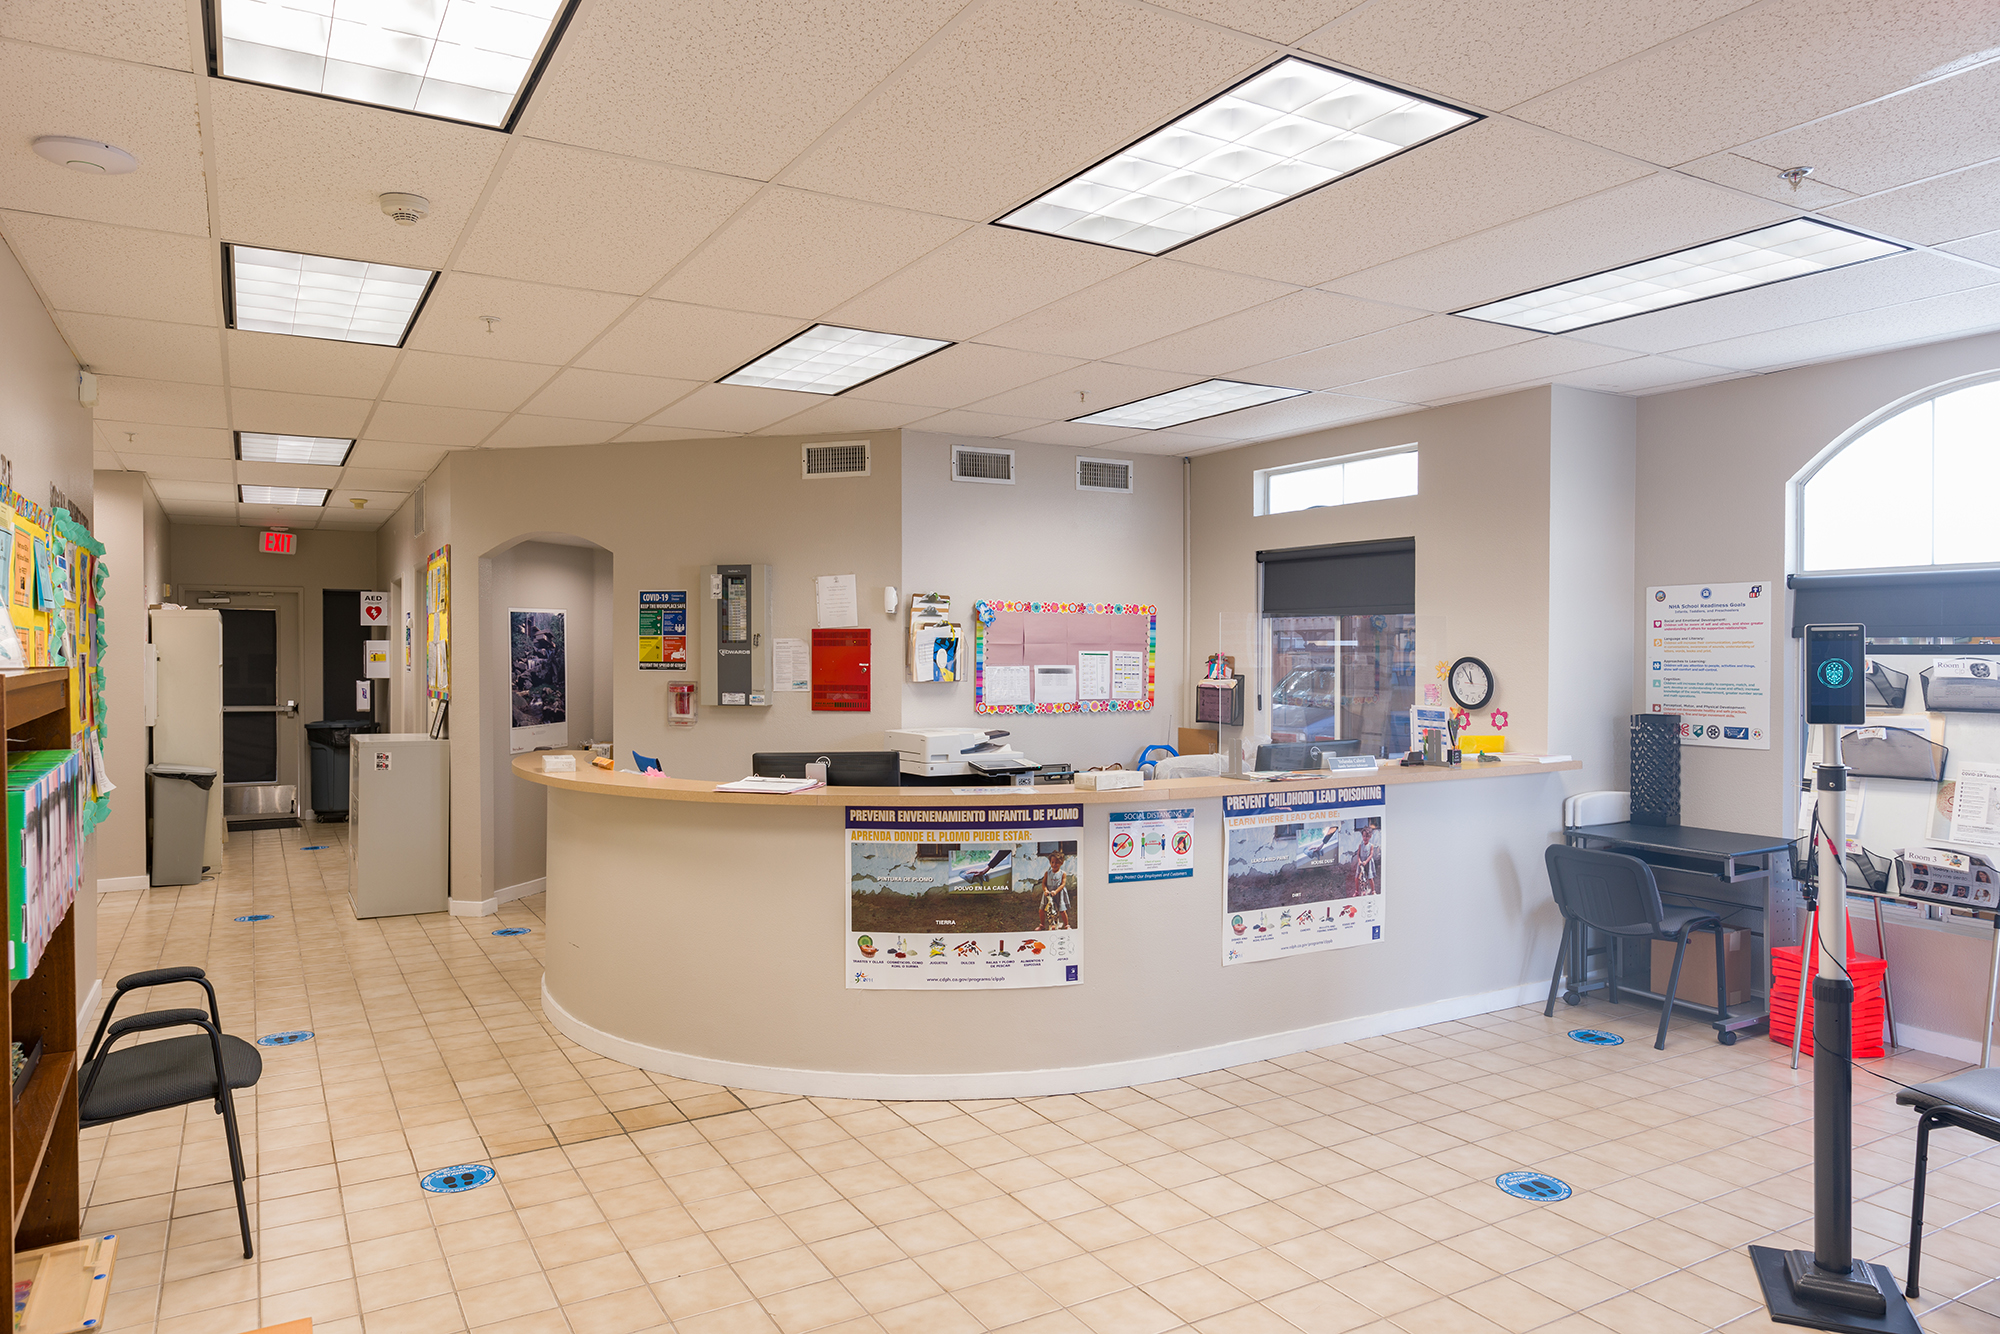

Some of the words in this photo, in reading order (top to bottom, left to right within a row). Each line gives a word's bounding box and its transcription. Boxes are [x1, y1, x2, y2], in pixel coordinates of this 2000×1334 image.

[265, 532, 292, 552] EXIT
[1227, 794, 1266, 810] PREVENT
[1268, 791, 1314, 807] CHILDHOOD
[1316, 789, 1336, 803] LEAD
[1338, 786, 1381, 802] POISONING
[850, 810, 896, 822] PREVENIR
[898, 810, 985, 822] ENVENENAMIENTO
[988, 809, 1031, 822] INFANTIL
[1033, 809, 1045, 820] DE
[1047, 808, 1079, 820] PLOMO
[1228, 816, 1256, 827] LEARN
[1258, 814, 1285, 824] WHERE
[1286, 812, 1307, 821] LEAD
[1309, 812, 1326, 820] CAN
[851, 831, 891, 841] APRENDA
[894, 831, 924, 841] DONDE
[927, 832, 936, 841] EL
[939, 832, 970, 841] PLOMO
[973, 831, 1000, 841] PUEDE
[1003, 830, 1032, 841] ESTAR:
[1908, 852, 1930, 861] Room
